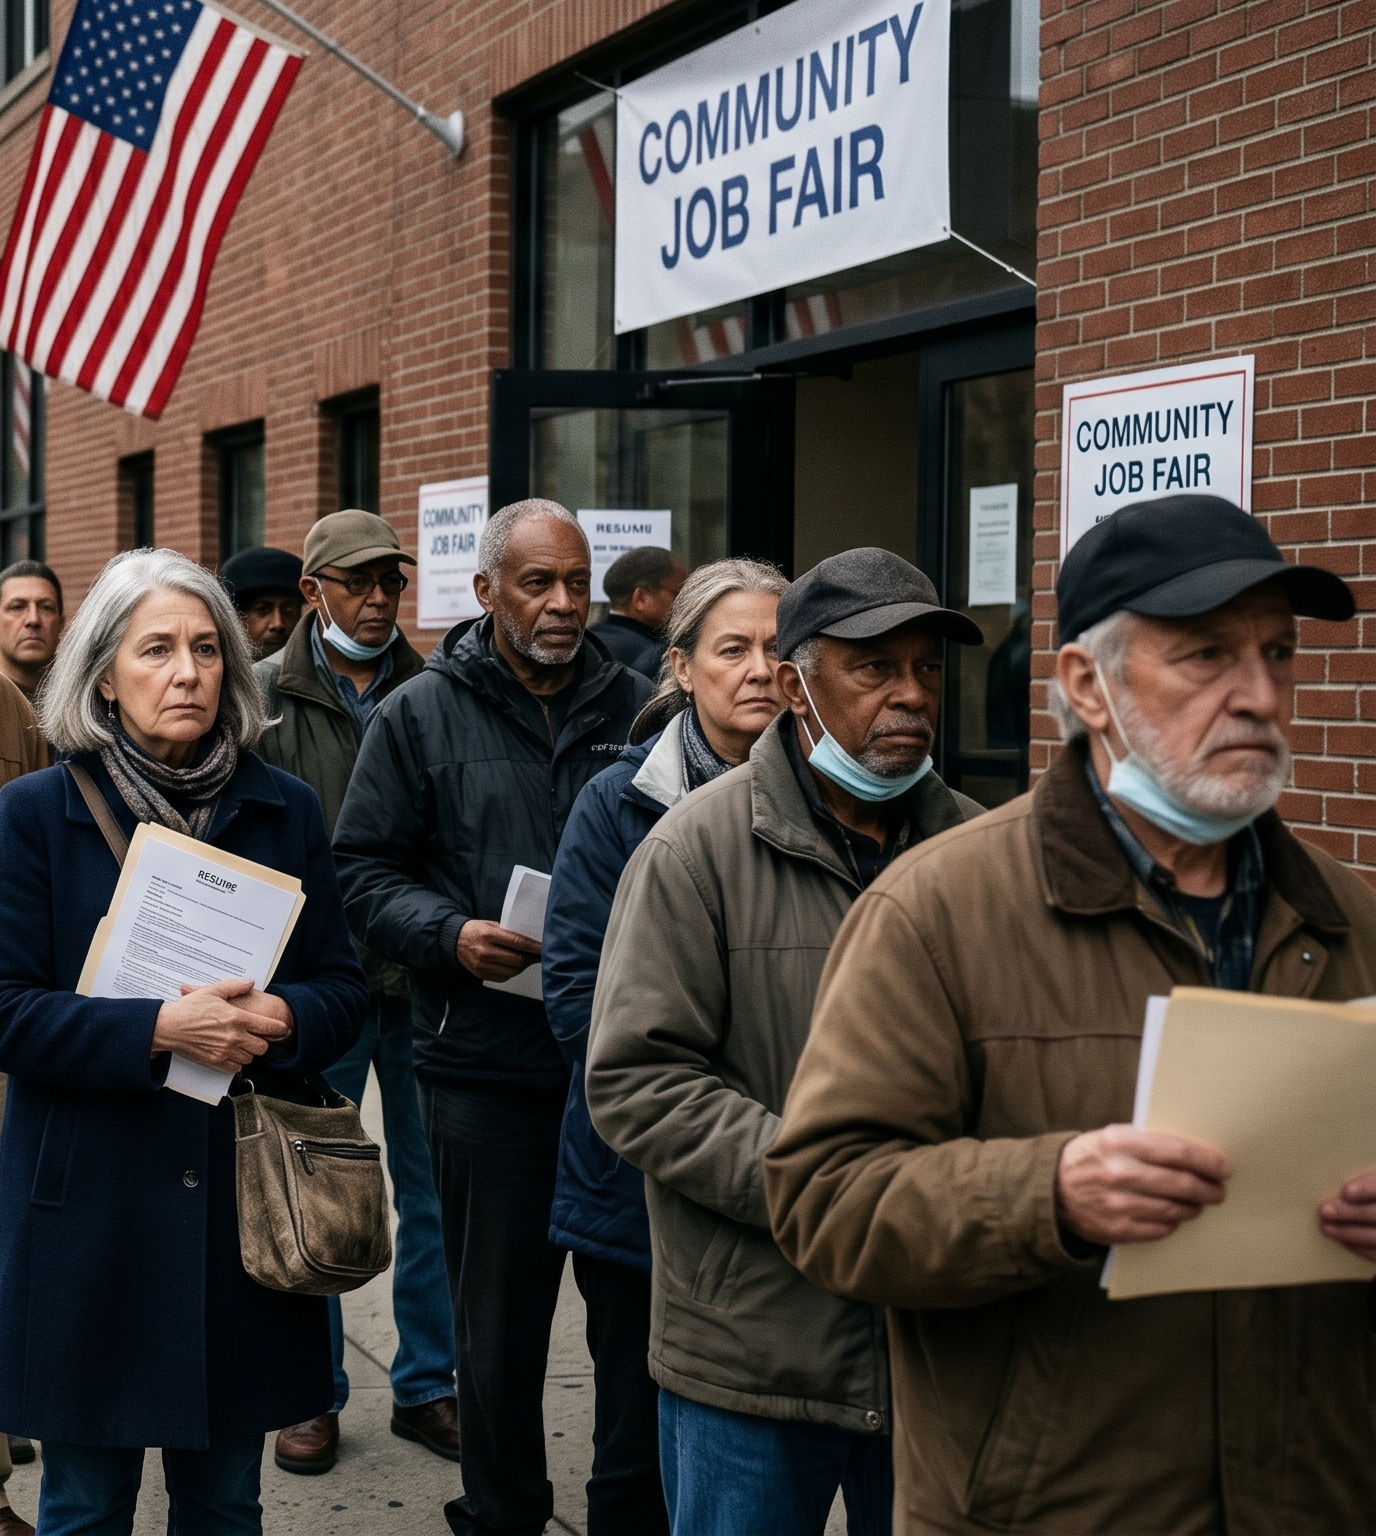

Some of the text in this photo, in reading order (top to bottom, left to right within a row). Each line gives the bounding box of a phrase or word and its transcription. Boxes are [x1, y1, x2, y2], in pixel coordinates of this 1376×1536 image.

[639, 2, 924, 185] COMMUNITY
[661, 124, 885, 270] JOB FAIR
[1076, 400, 1234, 453] COMMUNITY
[1094, 453, 1211, 497] JOB FAIR
[423, 503, 484, 528] COMMUNITY
[431, 533, 475, 555] JOB FAIR
